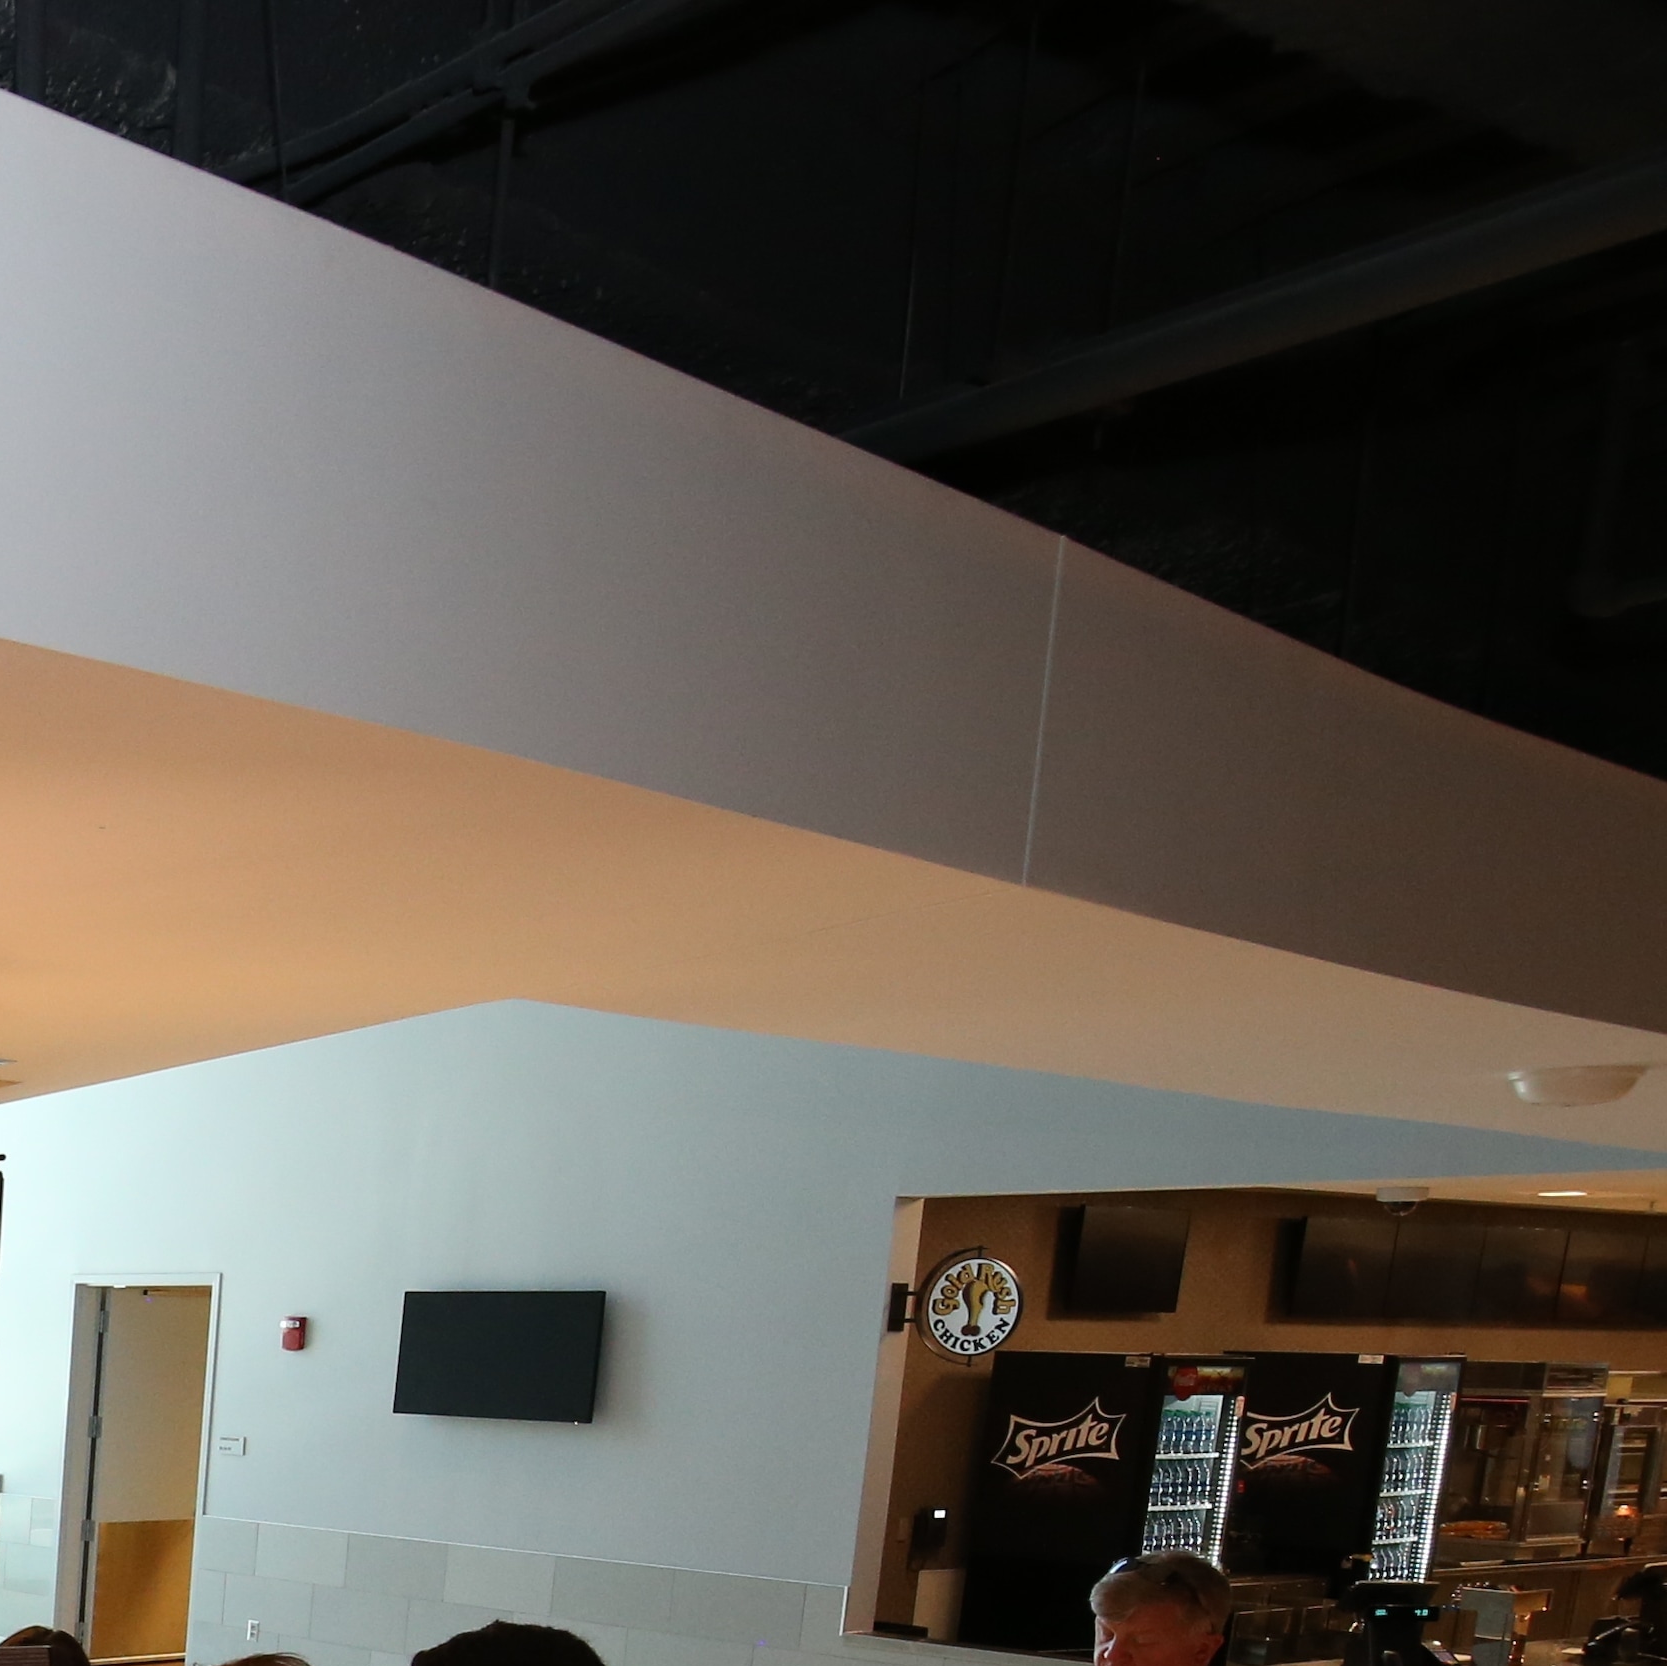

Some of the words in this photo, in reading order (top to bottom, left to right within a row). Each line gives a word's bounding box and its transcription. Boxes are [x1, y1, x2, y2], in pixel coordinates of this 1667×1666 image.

[932, 1263, 975, 1316] Gold
[977, 1263, 1017, 1316] Rush
[933, 1317, 1011, 1352] CHICKEN
[1006, 1413, 1110, 1468] Sprite
[1240, 1407, 1342, 1459] Sprite
